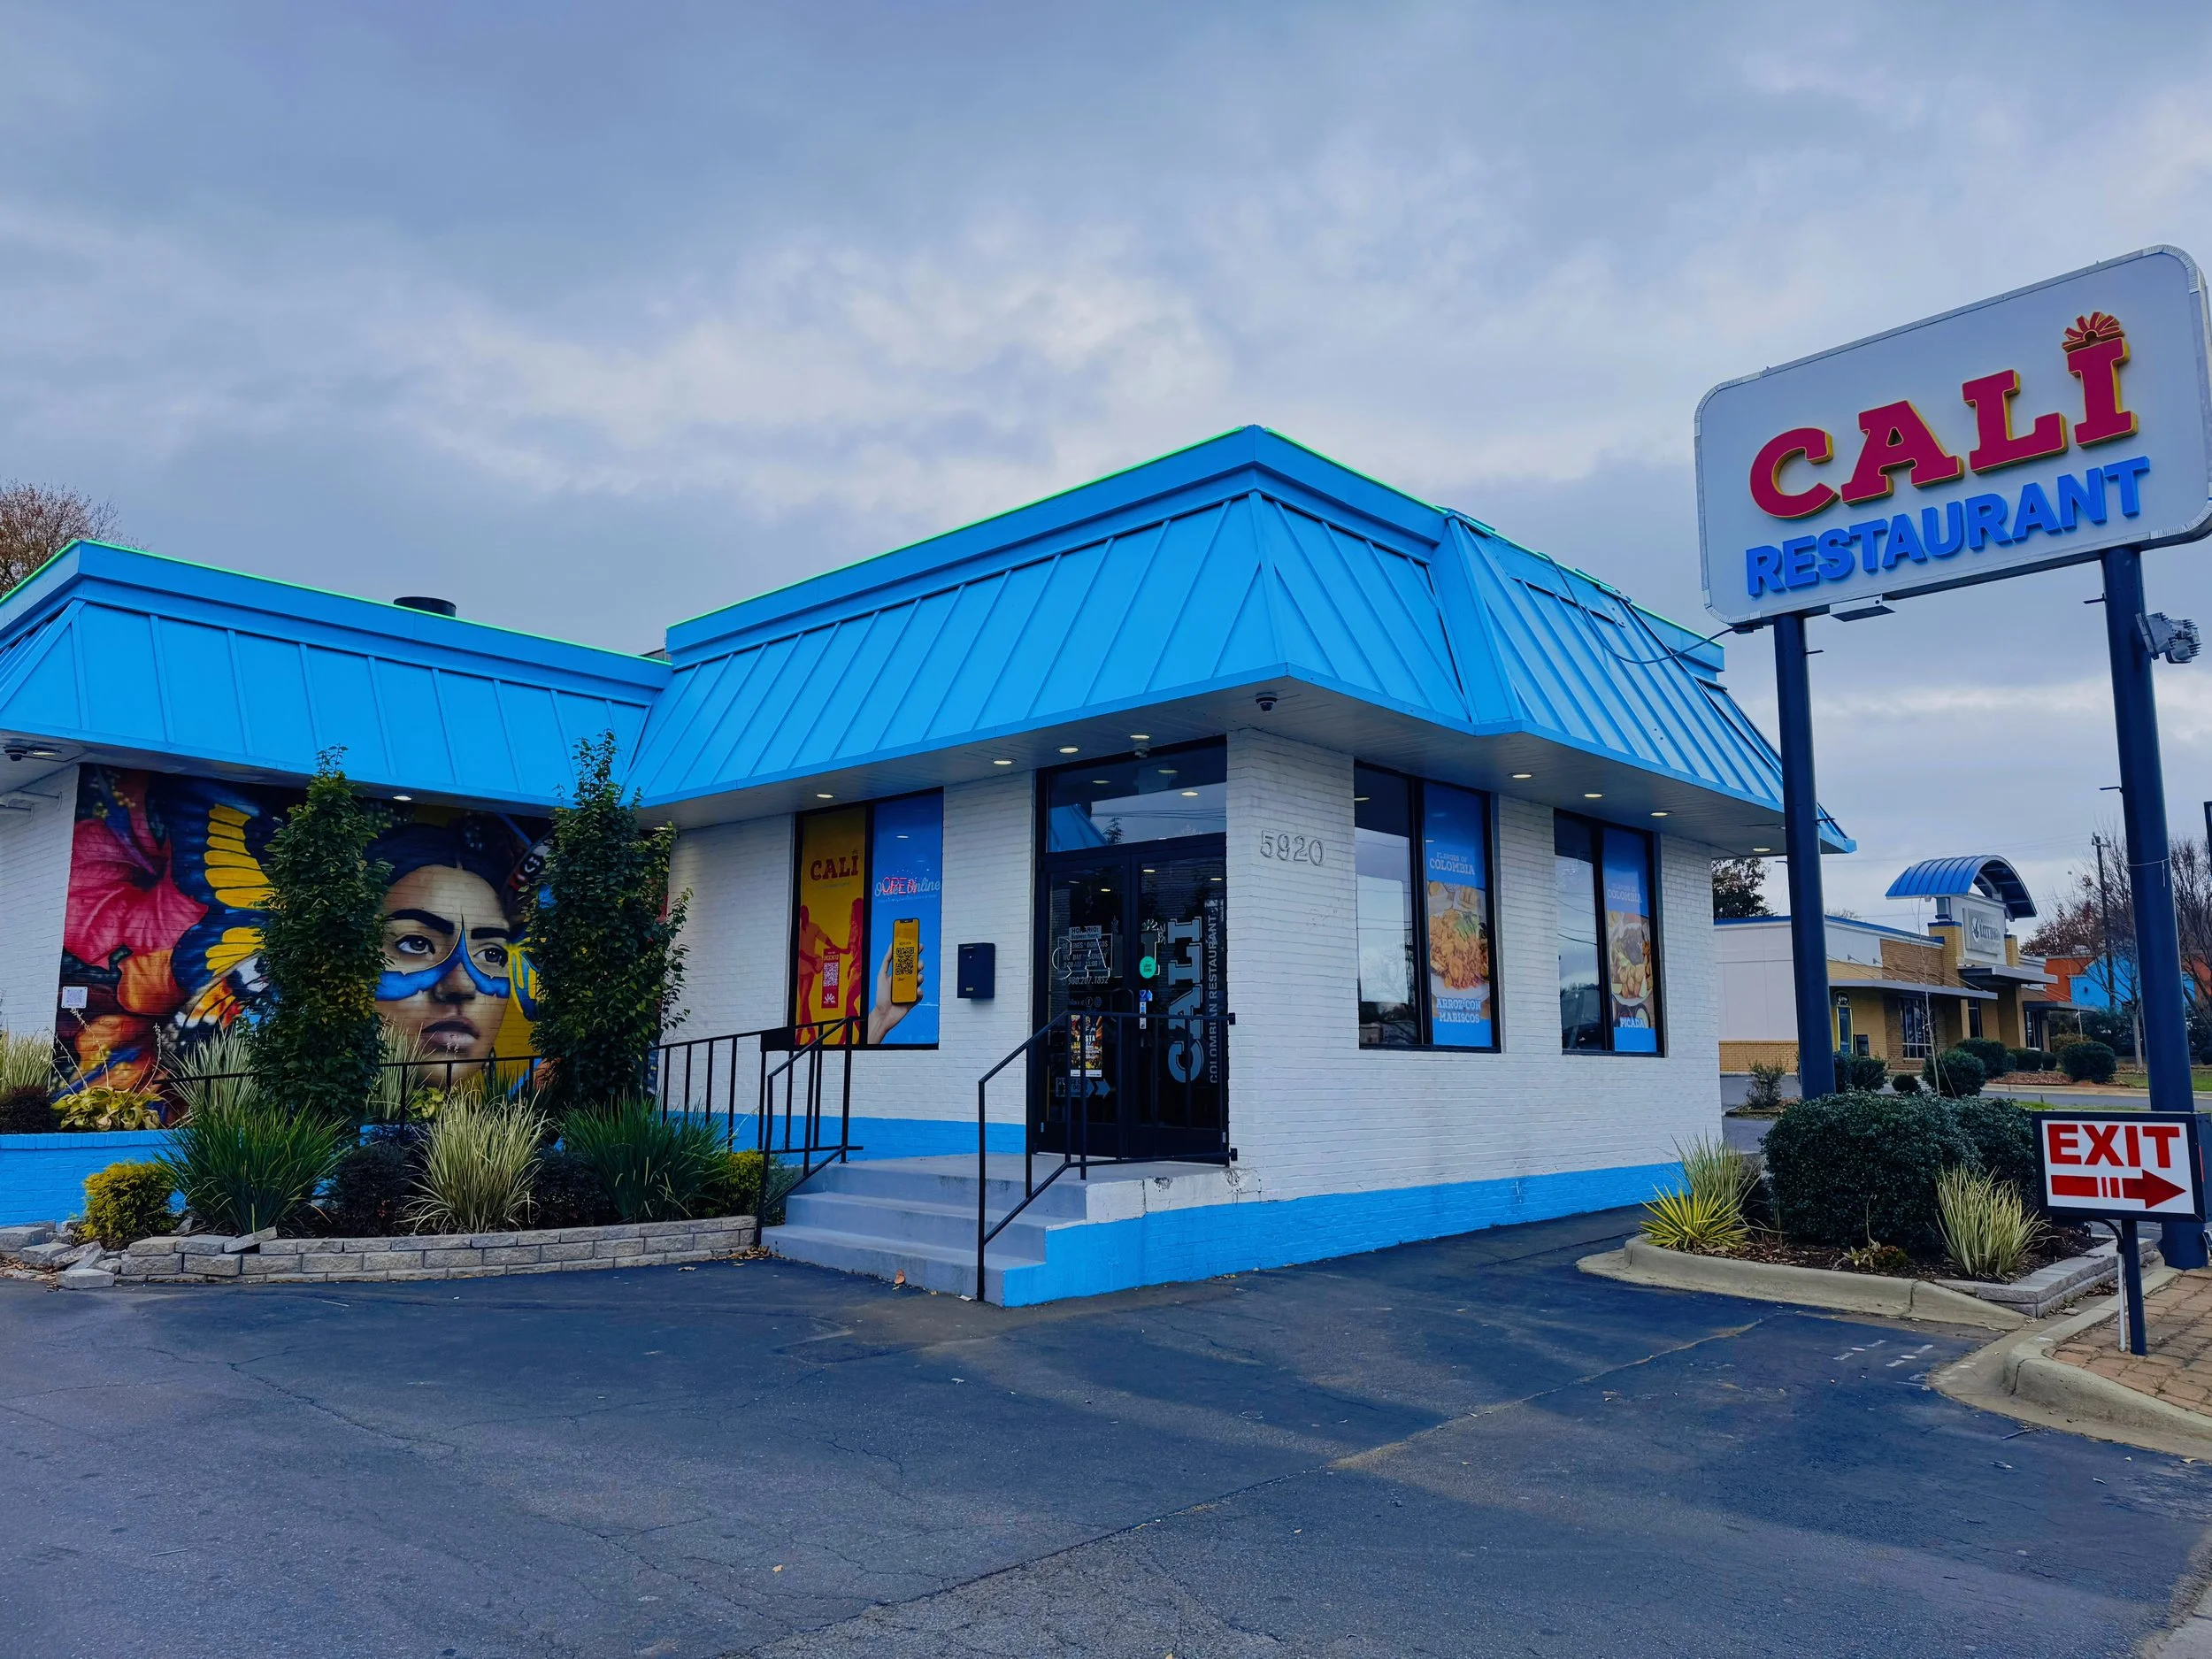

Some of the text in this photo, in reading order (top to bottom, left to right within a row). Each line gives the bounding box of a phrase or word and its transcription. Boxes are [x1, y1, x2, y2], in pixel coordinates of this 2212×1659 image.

[1749, 312, 2139, 518] CALI
[1745, 456, 2150, 599] RESTAURANT
[1260, 830, 1324, 866] 5920
[810, 850, 859, 880] CALI
[1429, 857, 1476, 875] COLOMBIA
[1607, 888, 1643, 902] COLOMBIA
[1206, 915, 1218, 1002] RESTAURANT
[1436, 998, 1481, 1010] ARROZ CON
[1440, 1011, 1480, 1024] MARISCOS
[1620, 1017, 1645, 1028] PICADA
[2047, 1124, 2180, 1168] EXIT
